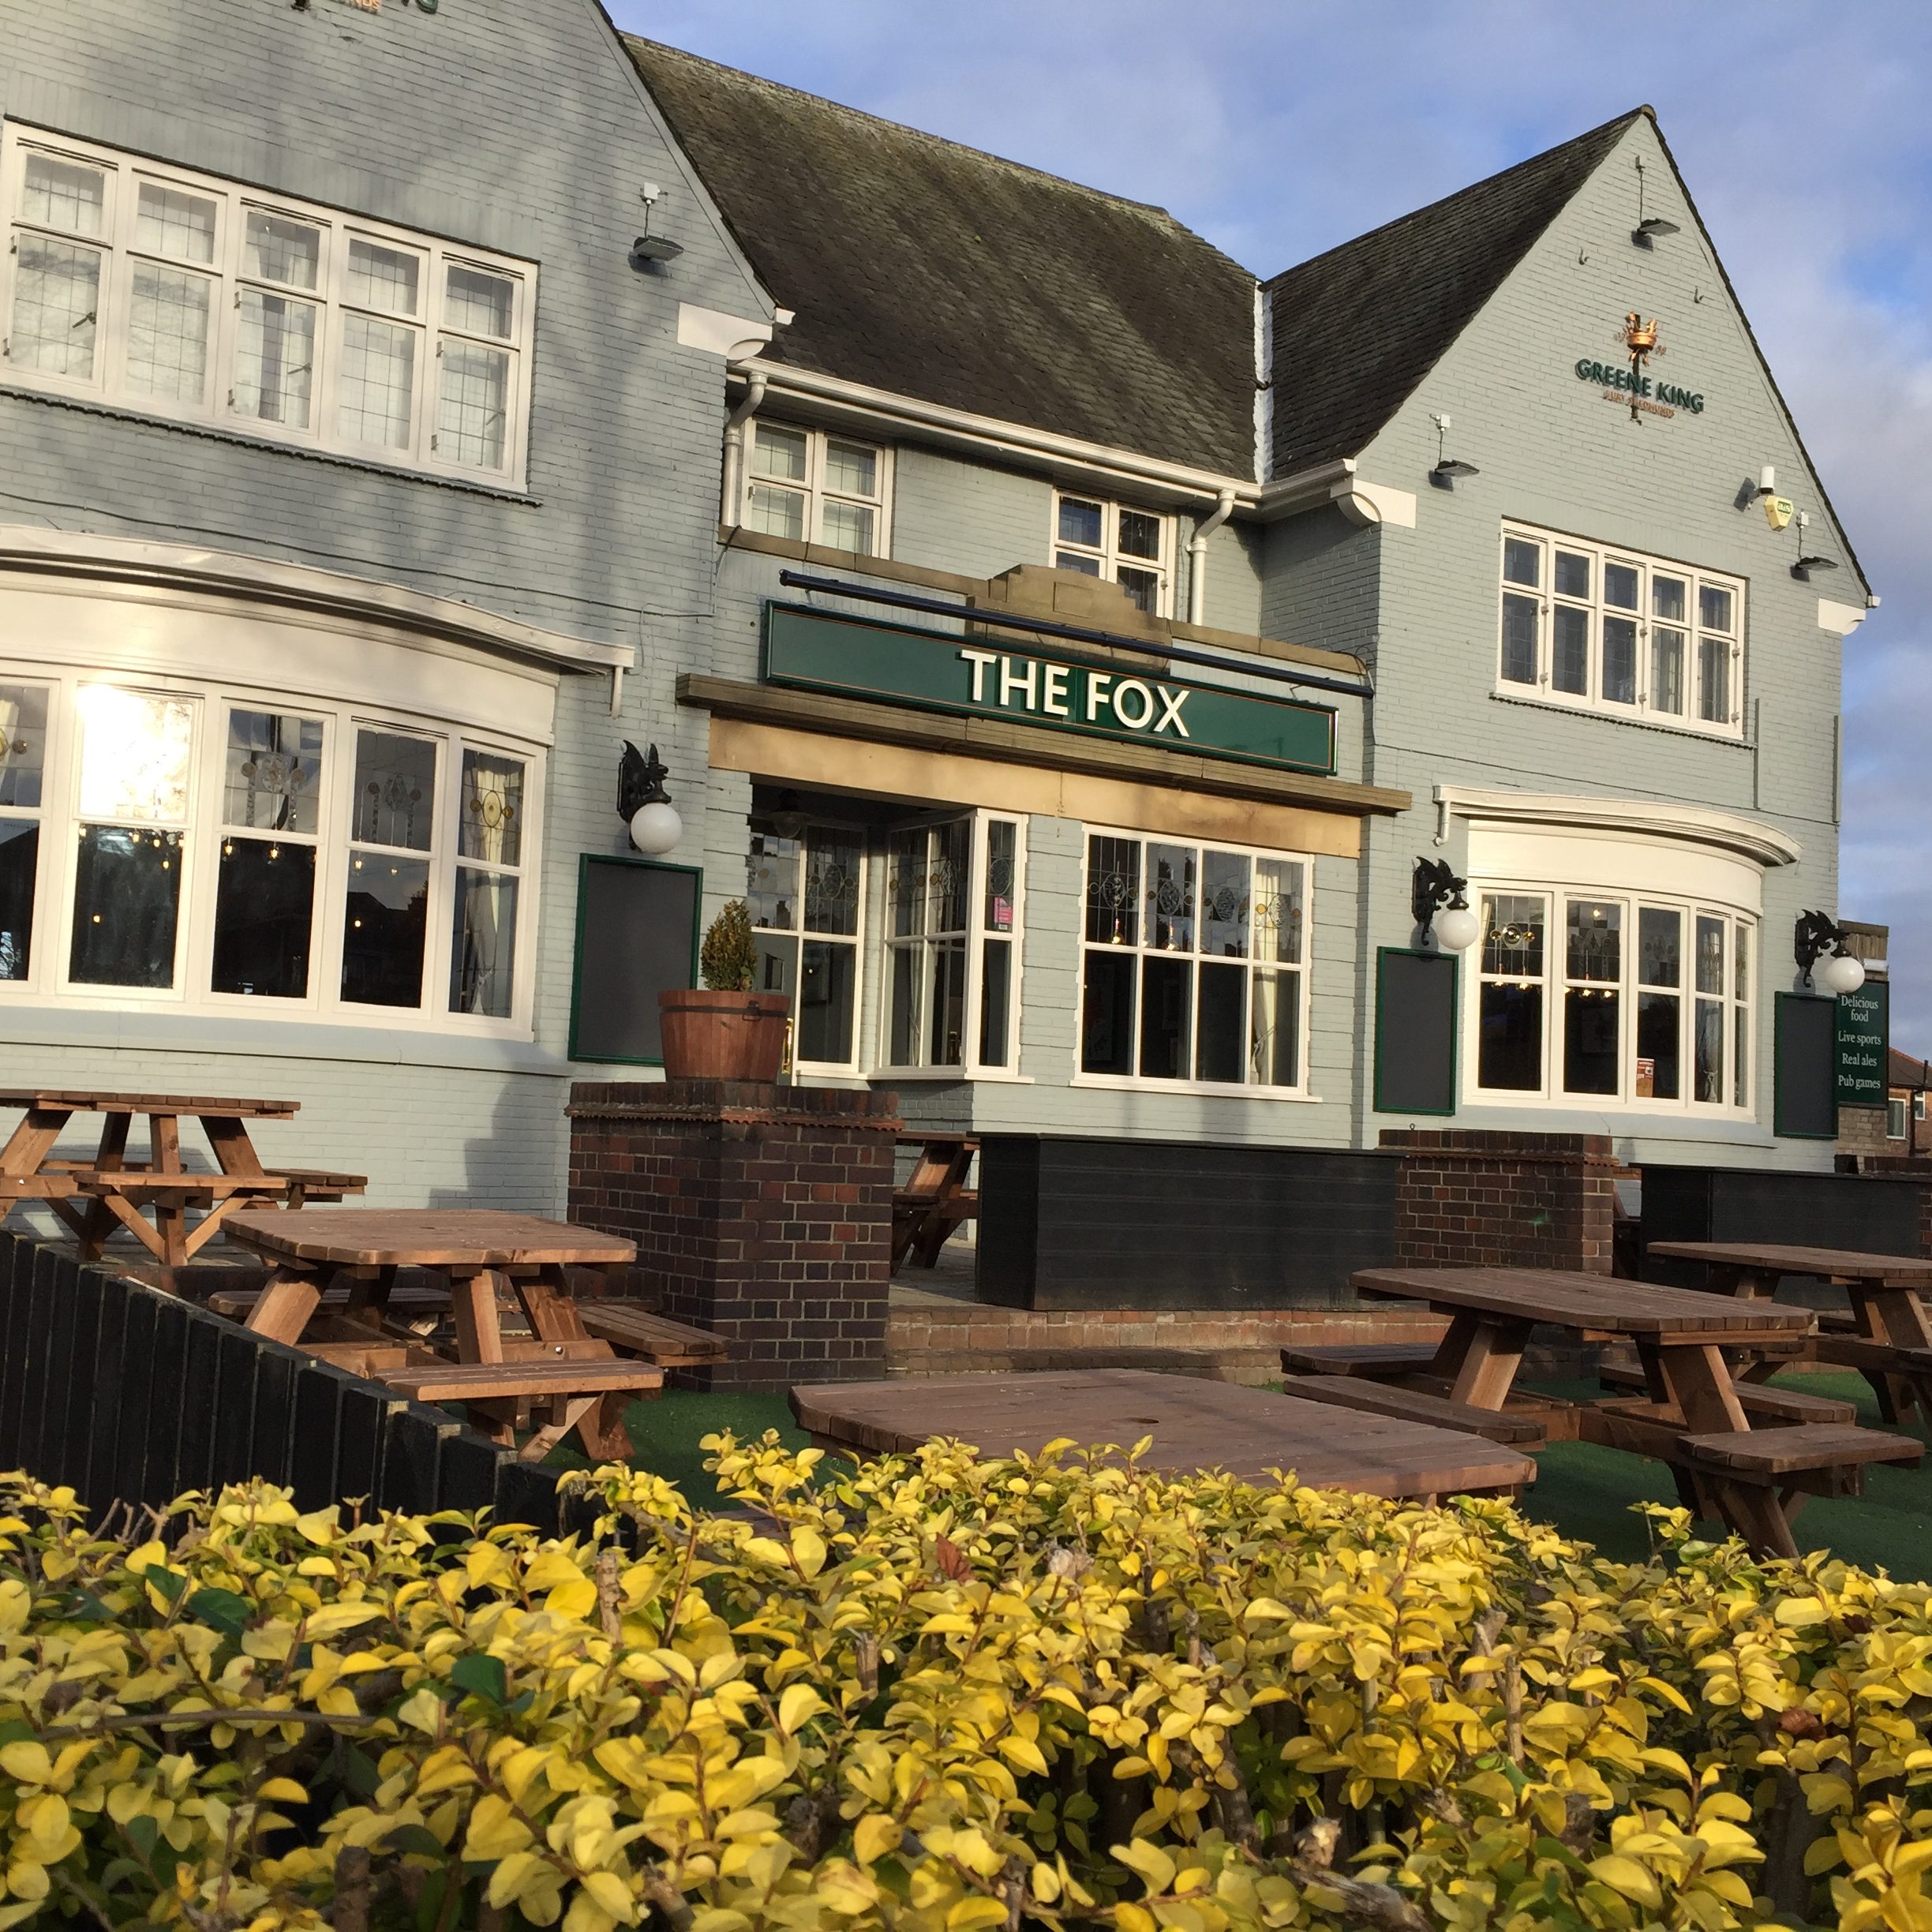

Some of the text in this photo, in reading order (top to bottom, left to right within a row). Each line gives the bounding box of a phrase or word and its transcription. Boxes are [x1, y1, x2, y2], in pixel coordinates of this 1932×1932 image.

[1577, 358, 1705, 414] GREENE KING
[960, 649, 1190, 738] THE FOX
[1840, 994, 1879, 1010] Delicious
[1851, 1009, 1869, 1022] food
[1838, 1030, 1882, 1046] Live sports
[1842, 1053, 1878, 1067] Real ales
[1838, 1074, 1881, 1091] Pub games
